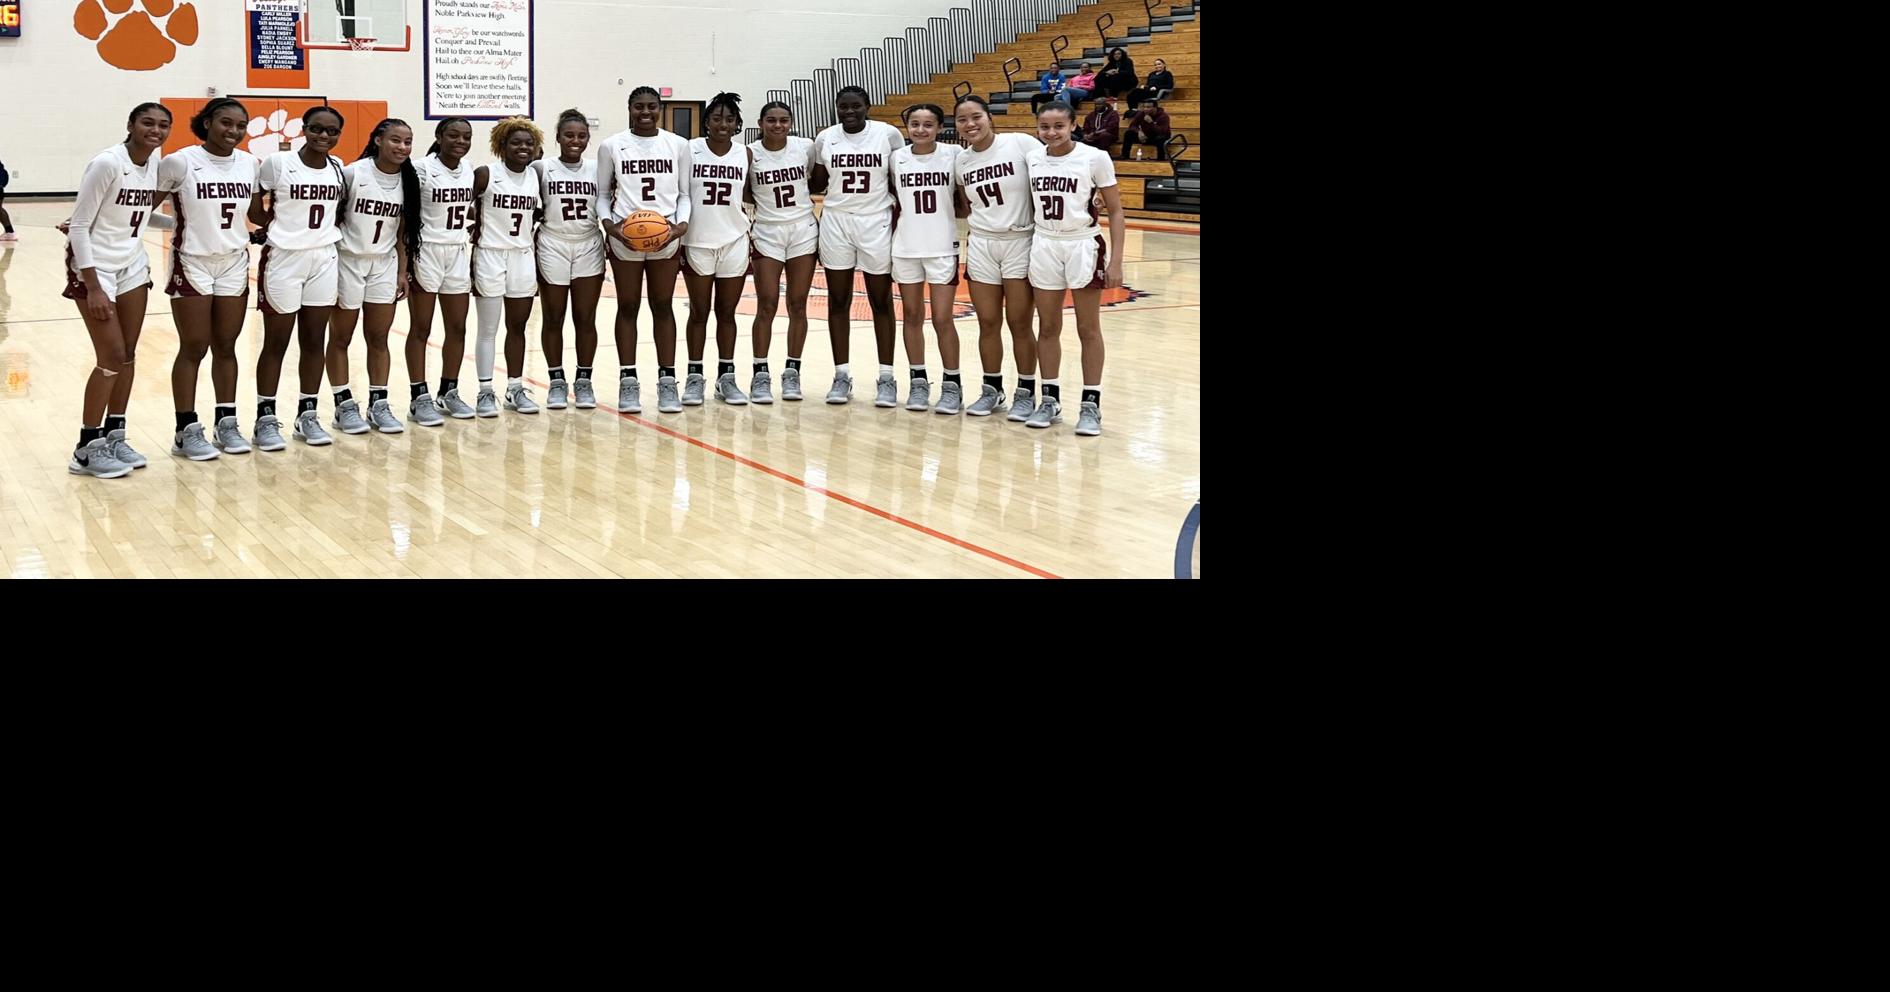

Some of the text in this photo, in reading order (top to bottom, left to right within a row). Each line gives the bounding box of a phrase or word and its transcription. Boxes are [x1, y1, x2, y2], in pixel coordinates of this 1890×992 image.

[457, 10, 486, 18] Parkview
[435, 38, 462, 46] Conquer
[478, 38, 501, 46] Prevail
[621, 159, 673, 174] HEBRON
[693, 164, 743, 180] HEBRON
[831, 154, 882, 168] HEBRON
[756, 165, 805, 185] HEBRON
[842, 171, 870, 194] 23
[900, 172, 950, 187] HEBRON
[963, 162, 1014, 186] HEBRON
[1032, 176, 1078, 193] HEBRON
[197, 182, 251, 199] HEBRON
[432, 188, 472, 202] HEBRO
[549, 181, 597, 197] HEBRON
[641, 177, 656, 202] 2
[702, 181, 732, 206] 32
[773, 184, 796, 208] 12
[976, 182, 1004, 208] 14
[560, 198, 588, 221] 22
[913, 190, 937, 214] 10
[1040, 195, 1064, 220] 20
[130, 211, 144, 238] 4
[220, 203, 236, 229] 5
[308, 204, 325, 229] 0
[446, 206, 465, 230] 15
[509, 213, 523, 236] 3
[372, 220, 384, 244] 1
